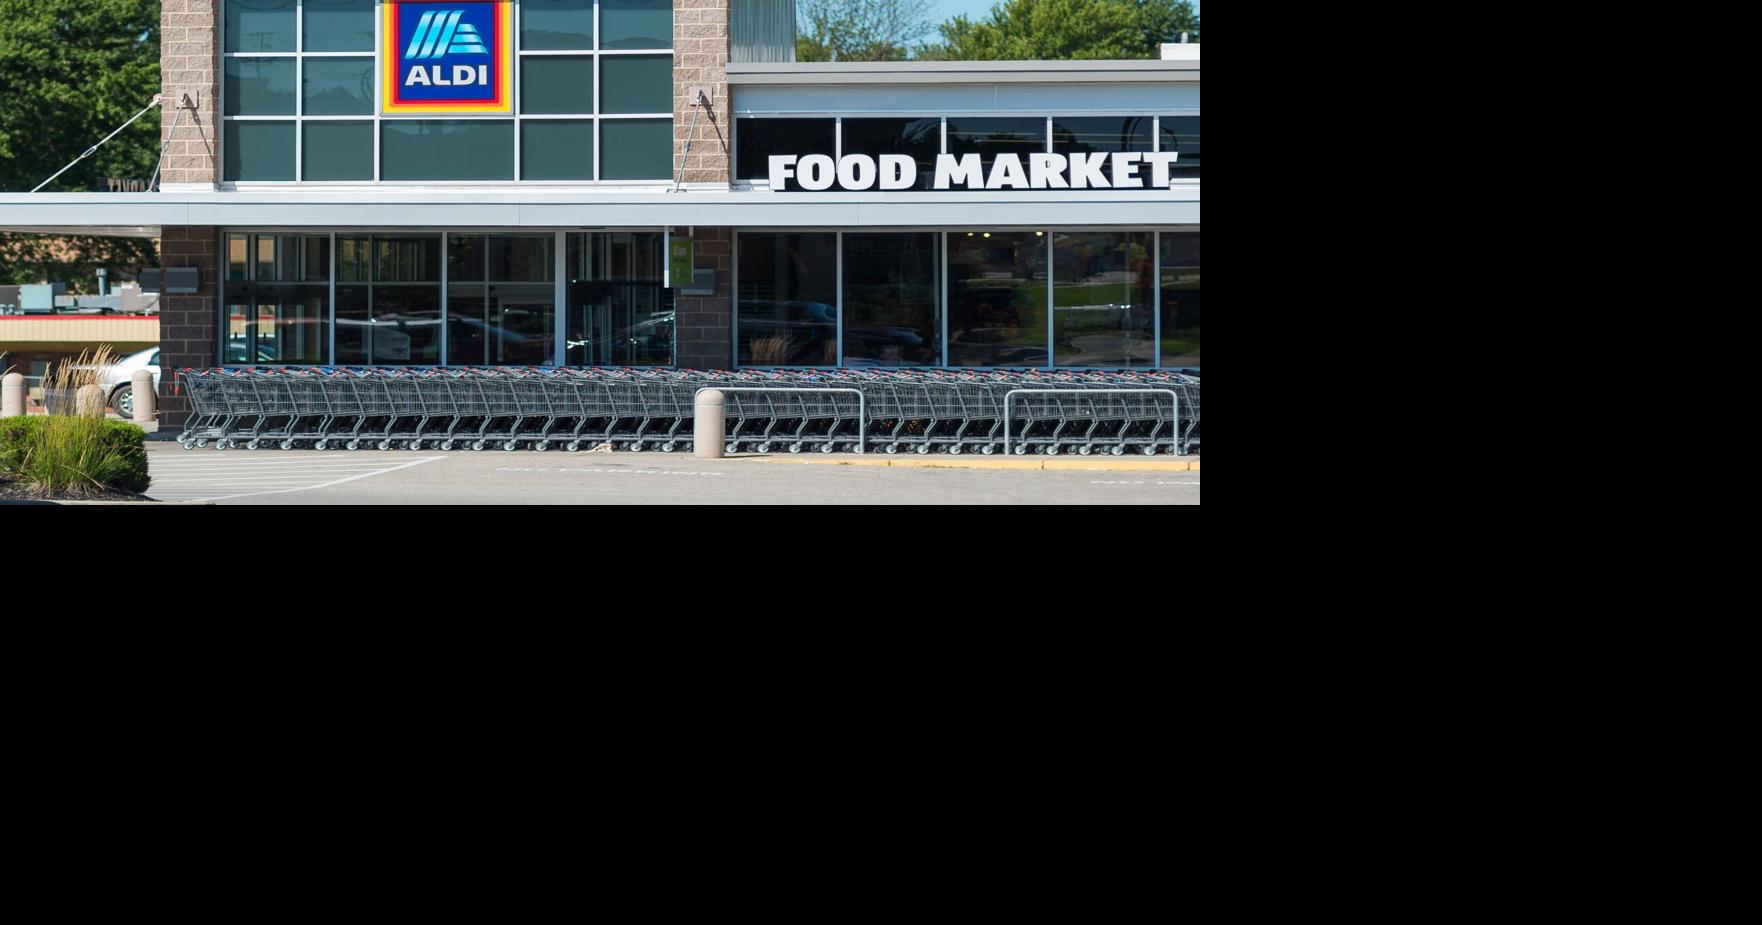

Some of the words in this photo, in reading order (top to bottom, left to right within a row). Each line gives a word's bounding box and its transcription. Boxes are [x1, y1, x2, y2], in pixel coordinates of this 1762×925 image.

[405, 65, 487, 86] ALDI
[768, 153, 917, 191] FOOD
[934, 151, 1178, 190] MARKET
